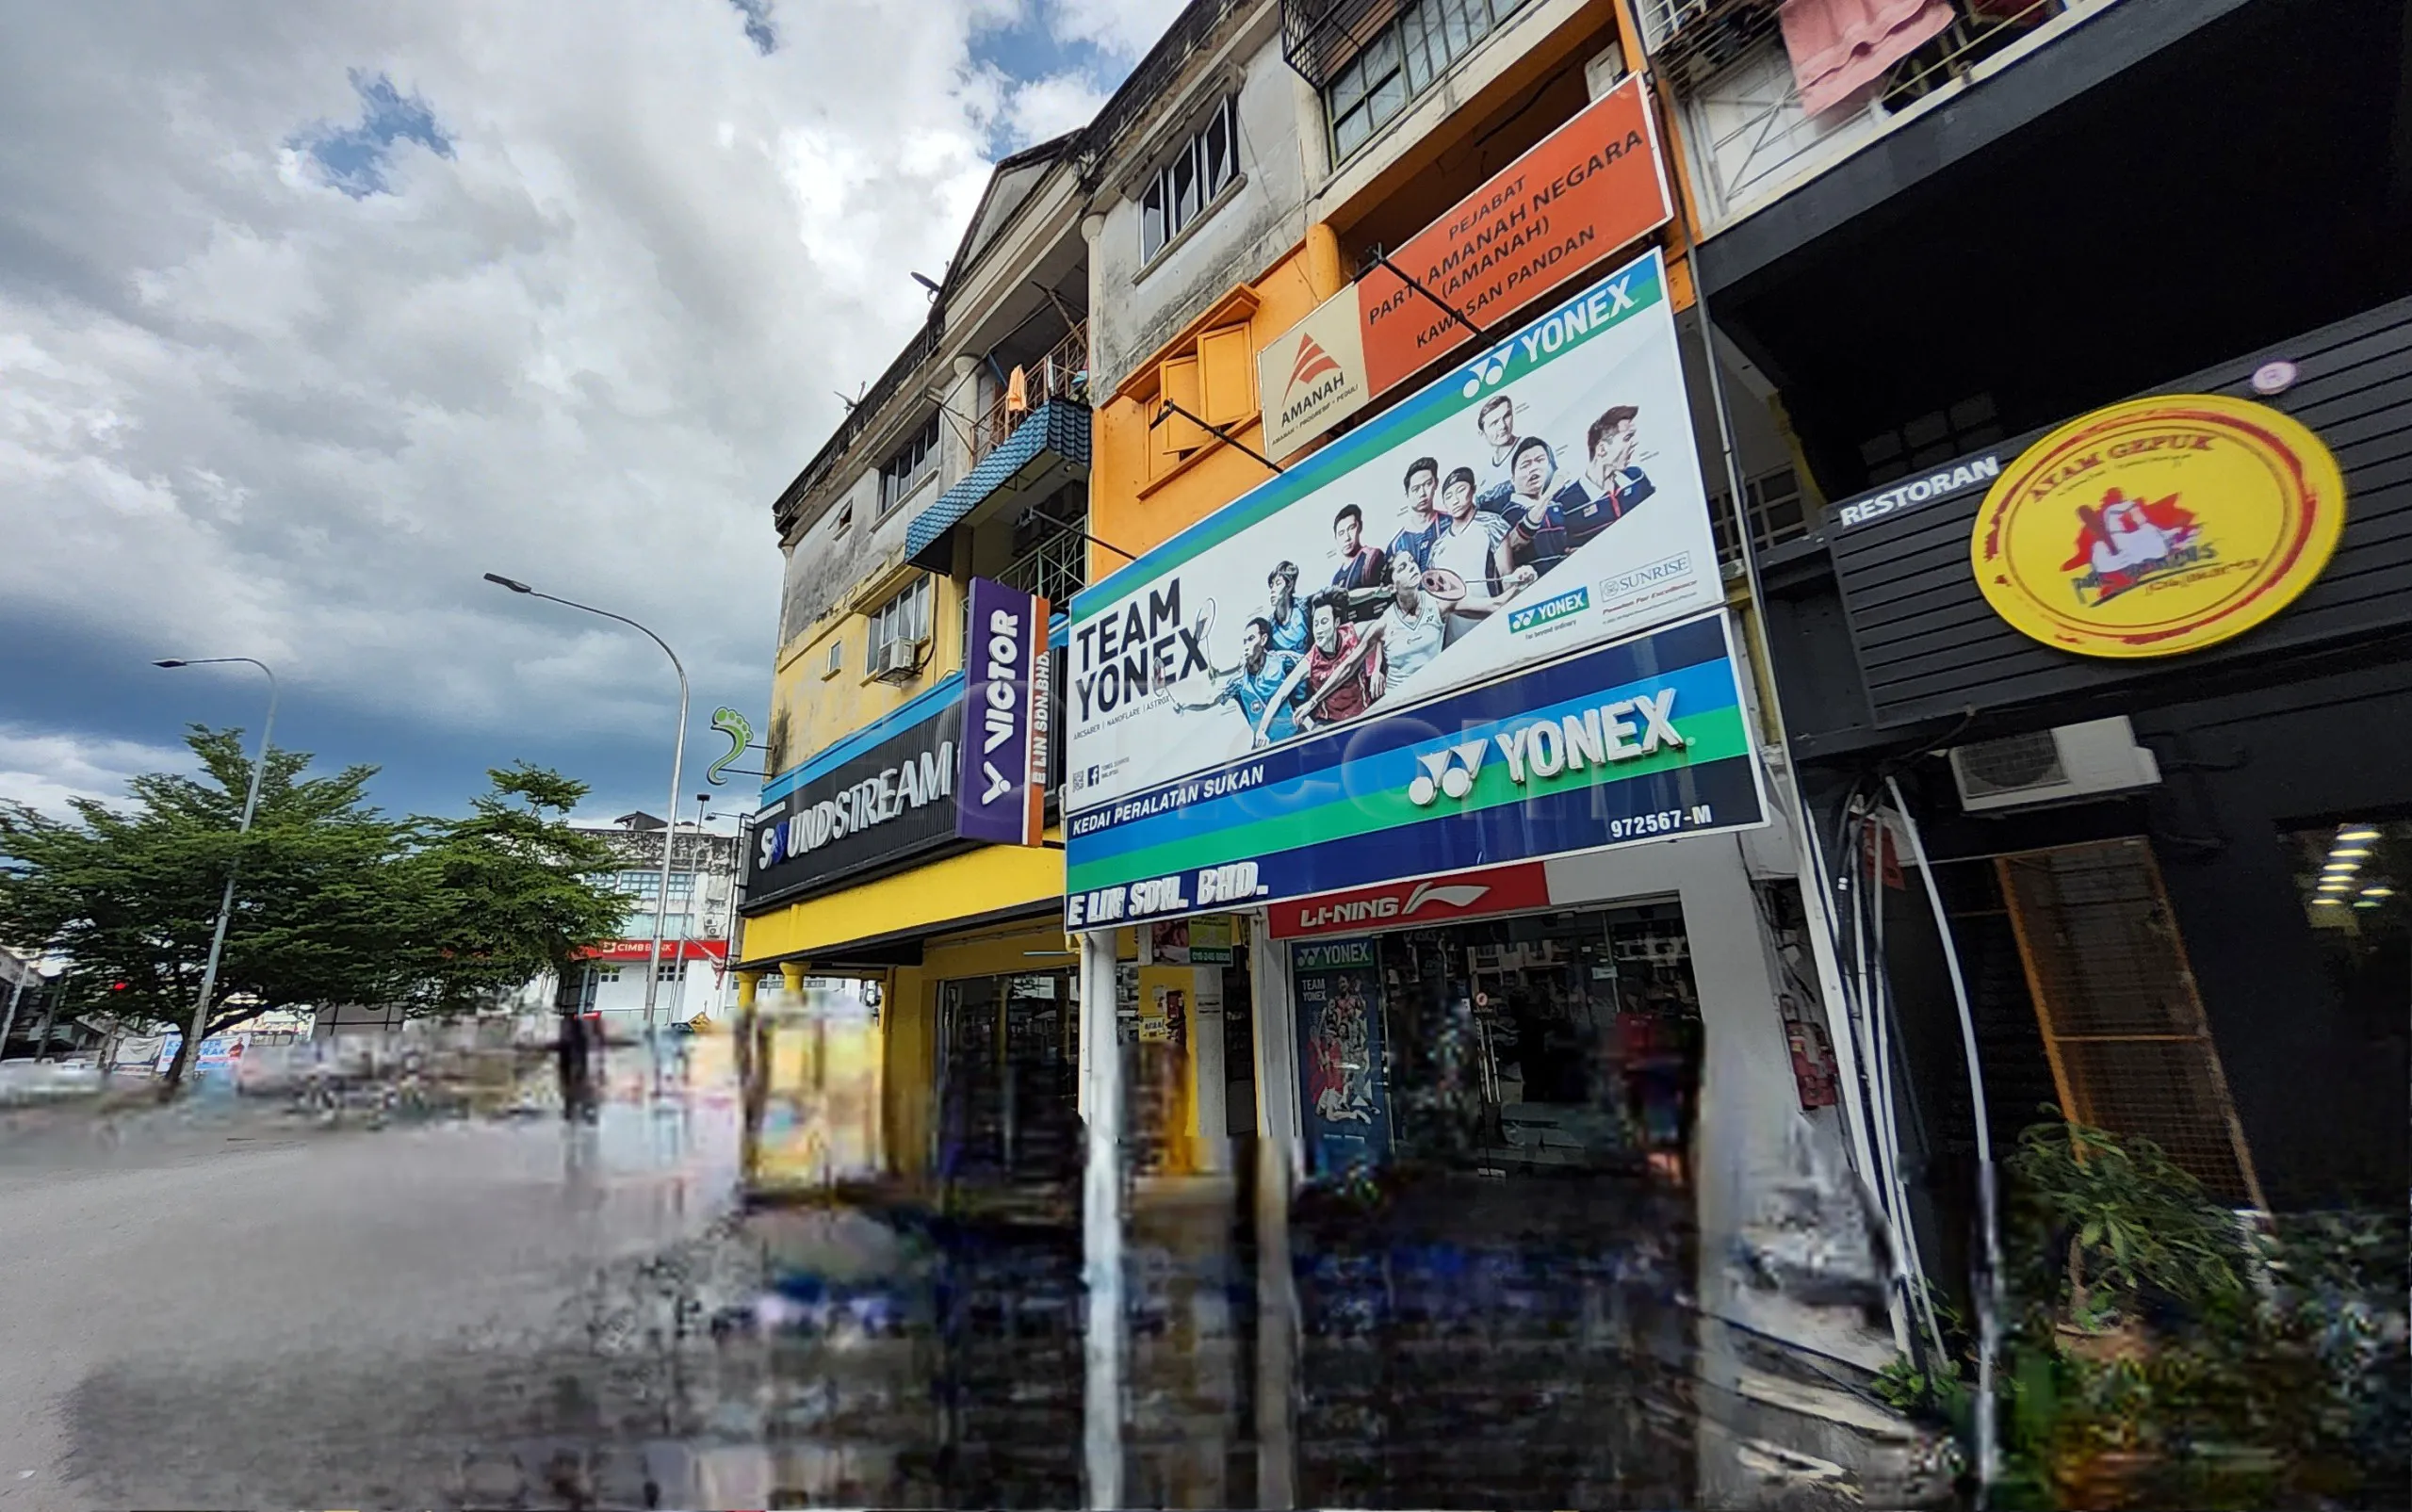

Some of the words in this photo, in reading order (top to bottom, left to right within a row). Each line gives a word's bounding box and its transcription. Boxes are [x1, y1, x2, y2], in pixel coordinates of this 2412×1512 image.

[1369, 278, 1421, 326] PARTI
[1427, 203, 1526, 285] AMANAH
[1532, 129, 1644, 212] NEGARA
[1448, 174, 1526, 241] PEJABAT
[1442, 215, 1550, 300] (AMANAH)
[1508, 225, 1595, 290] PANDAN
[1519, 273, 1636, 364] YONEX
[1281, 371, 1345, 428] AMANAH
[1839, 456, 1999, 528] RESTORAN
[2029, 451, 2105, 503] AYAM
[2108, 434, 2216, 460] GEPUK
[1538, 592, 1585, 620] YONEX
[1620, 557, 1688, 591] SUNRISE
[1076, 577, 1182, 675] TEAM
[985, 610, 1018, 754] VICTOR
[1074, 626, 1209, 723] YONEX
[1032, 736, 1048, 767] LIN
[1494, 687, 1686, 785] YONEX
[1032, 772, 1046, 784] E
[1071, 811, 1111, 836] KEDAI
[1114, 778, 1198, 823] PERALATAN
[1203, 764, 1264, 799] SUKAN
[1610, 804, 1713, 838] 972567-M
[1067, 894, 1088, 926] E
[1088, 886, 1126, 923] LIN
[1129, 876, 1189, 917] SDN.
[1197, 861, 1269, 905] BHD.
[1300, 897, 1399, 928] LI-NING
[617, 943, 644, 952] CIMB
[644, 943, 673, 952] BNK
[1323, 942, 1369, 964] YONEX
[1301, 977, 1326, 991] TEAM
[1302, 990, 1328, 1001] YONEX
